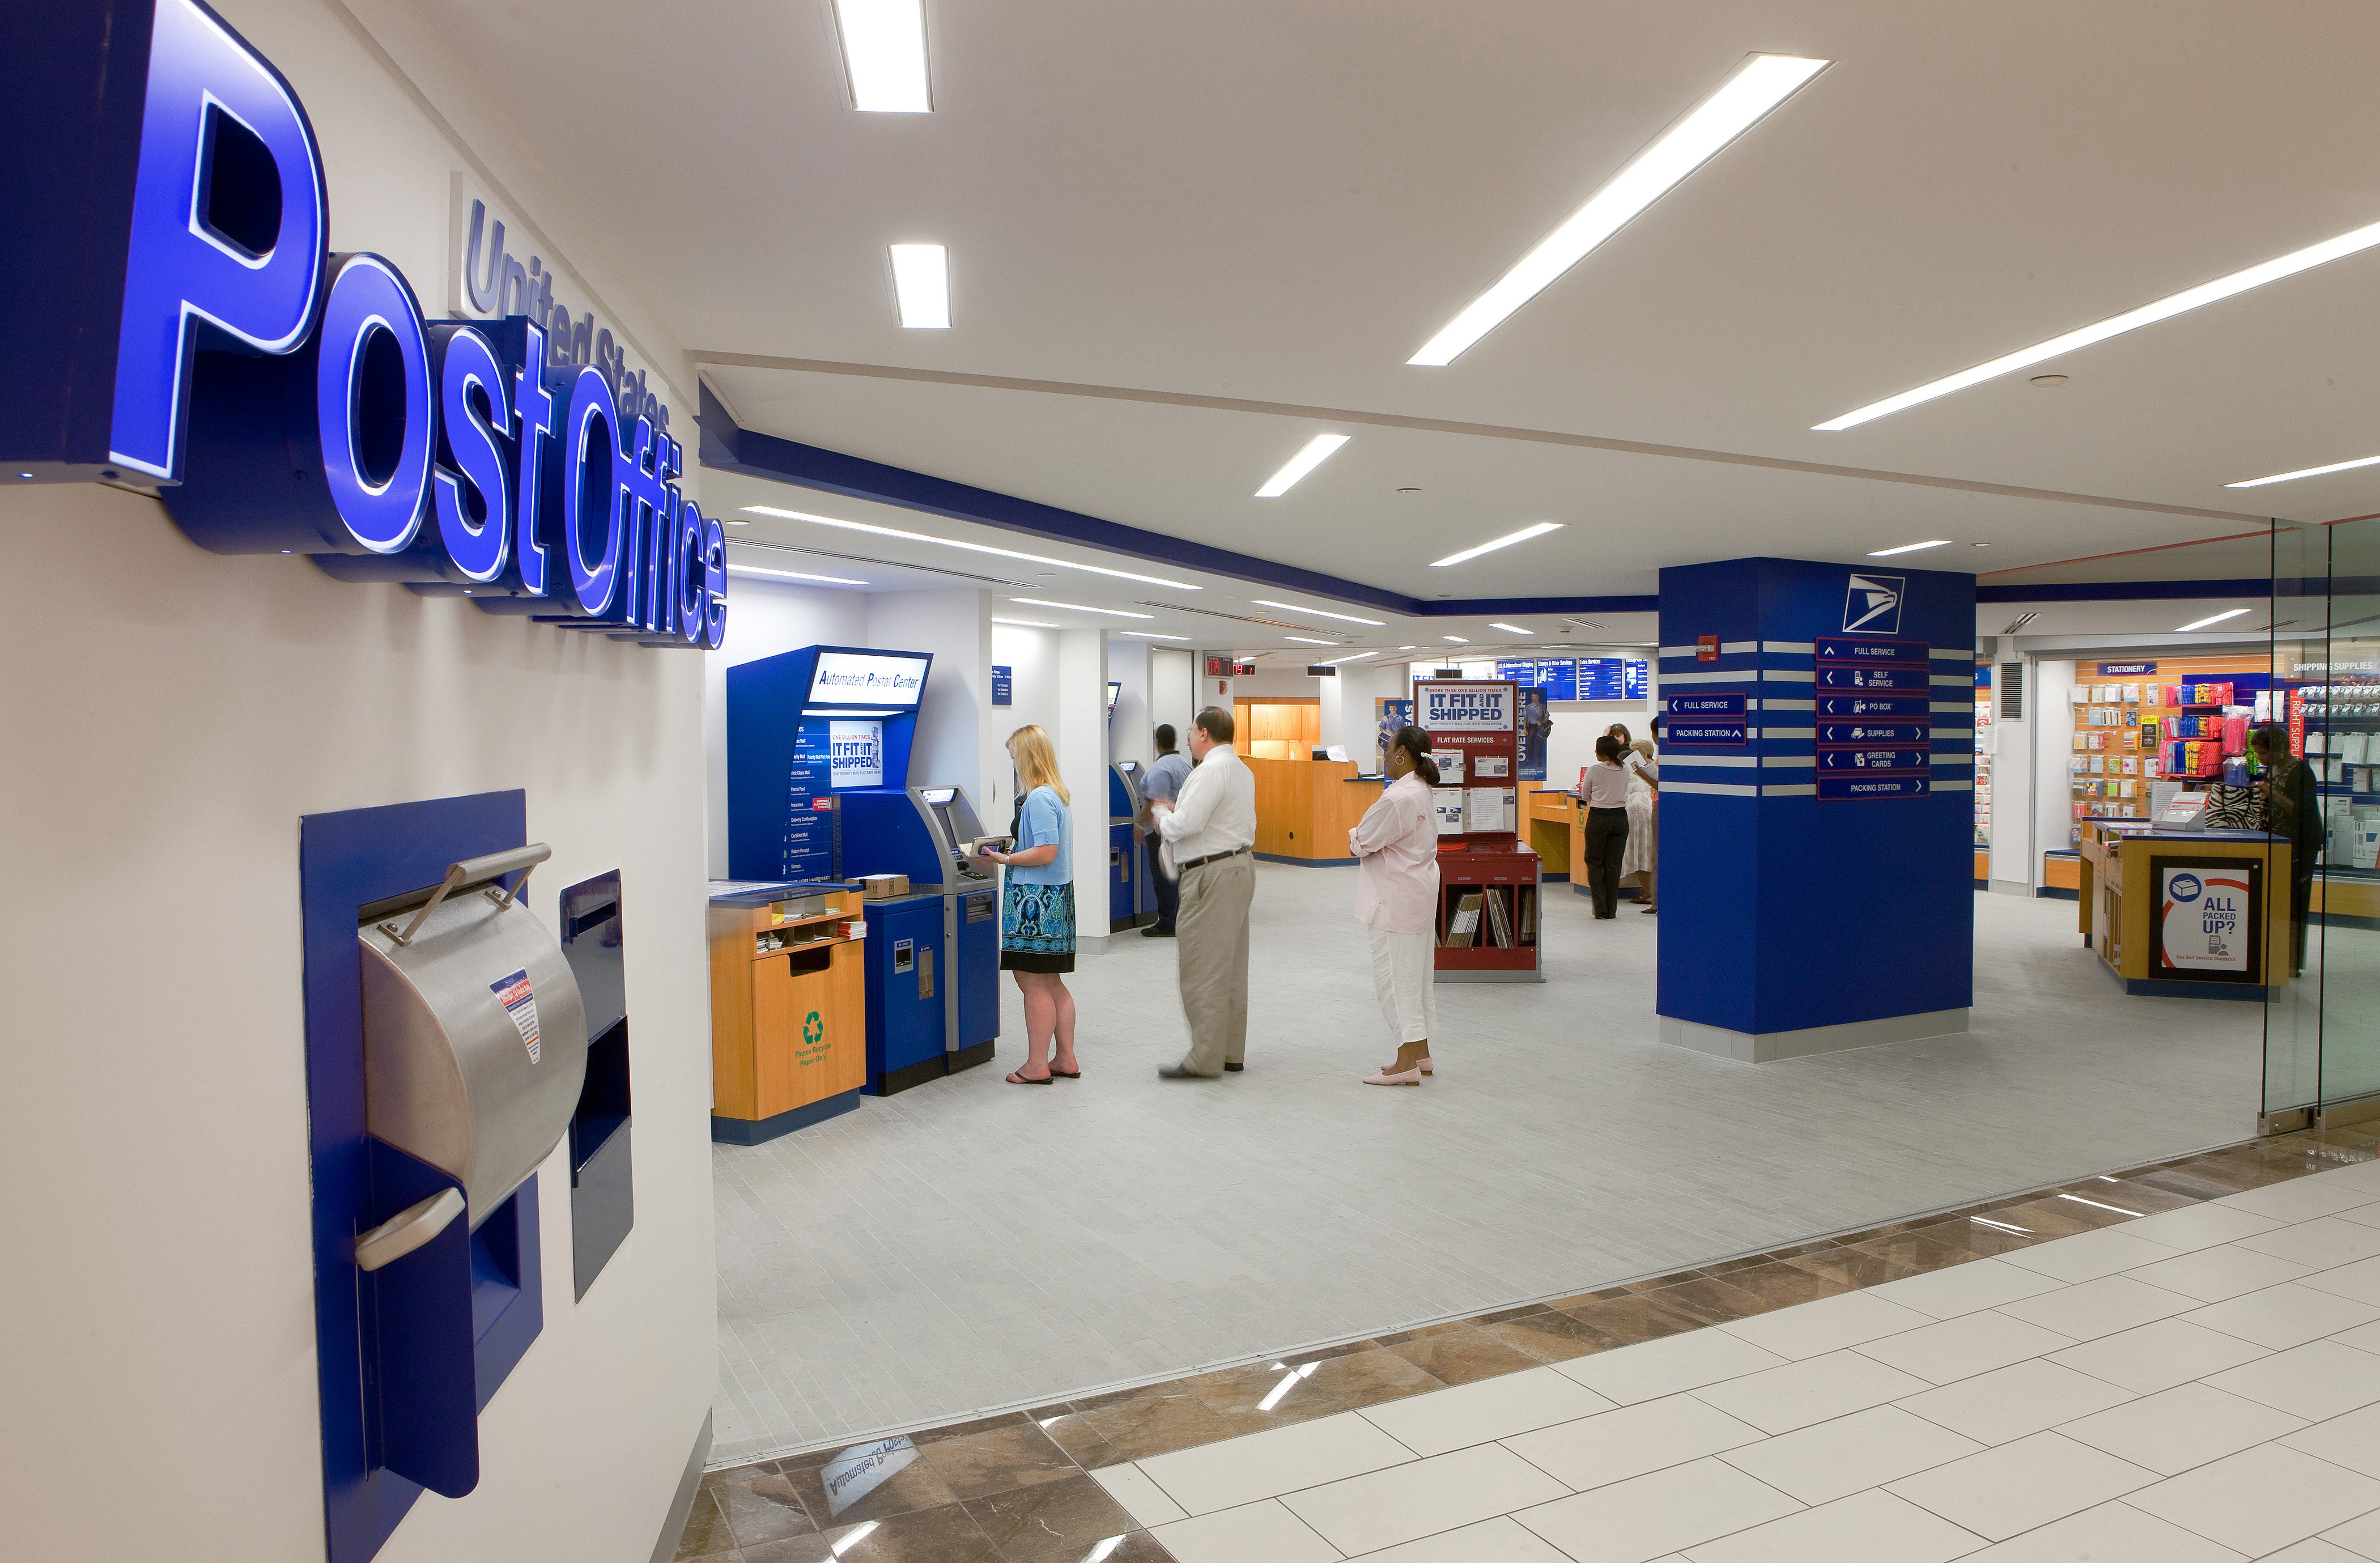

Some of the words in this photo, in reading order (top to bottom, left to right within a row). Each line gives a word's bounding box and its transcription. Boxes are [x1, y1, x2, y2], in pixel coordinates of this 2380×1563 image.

[466, 198, 594, 366] United
[596, 328, 669, 431] States
[110, 0, 555, 598] Post
[567, 364, 728, 650] Office
[2107, 665, 2145, 673] STATIONERY
[2293, 662, 2332, 672] SHIPPING
[2334, 661, 2373, 670] SUPPLIES
[819, 670, 866, 686] Automated
[866, 673, 892, 687] Postal
[893, 674, 919, 689] Center
[1430, 694, 1446, 707] IT
[1450, 694, 1477, 707] FIT
[1486, 694, 1502, 707] IT
[1429, 708, 1502, 720] SHIPPED
[2292, 700, 2301, 727] RIGHT
[832, 742, 842, 756] IT
[843, 742, 860, 756] FIT
[863, 742, 872, 755] IT
[2291, 728, 2300, 759] SUPPLI
[832, 757, 872, 769] SHIPPED
[2203, 897, 2236, 912] ALL
[2203, 920, 2236, 935] UP?
[795, 1049, 811, 1058] Please
[813, 1043, 831, 1053] Recycle
[800, 1058, 814, 1067] Paper
